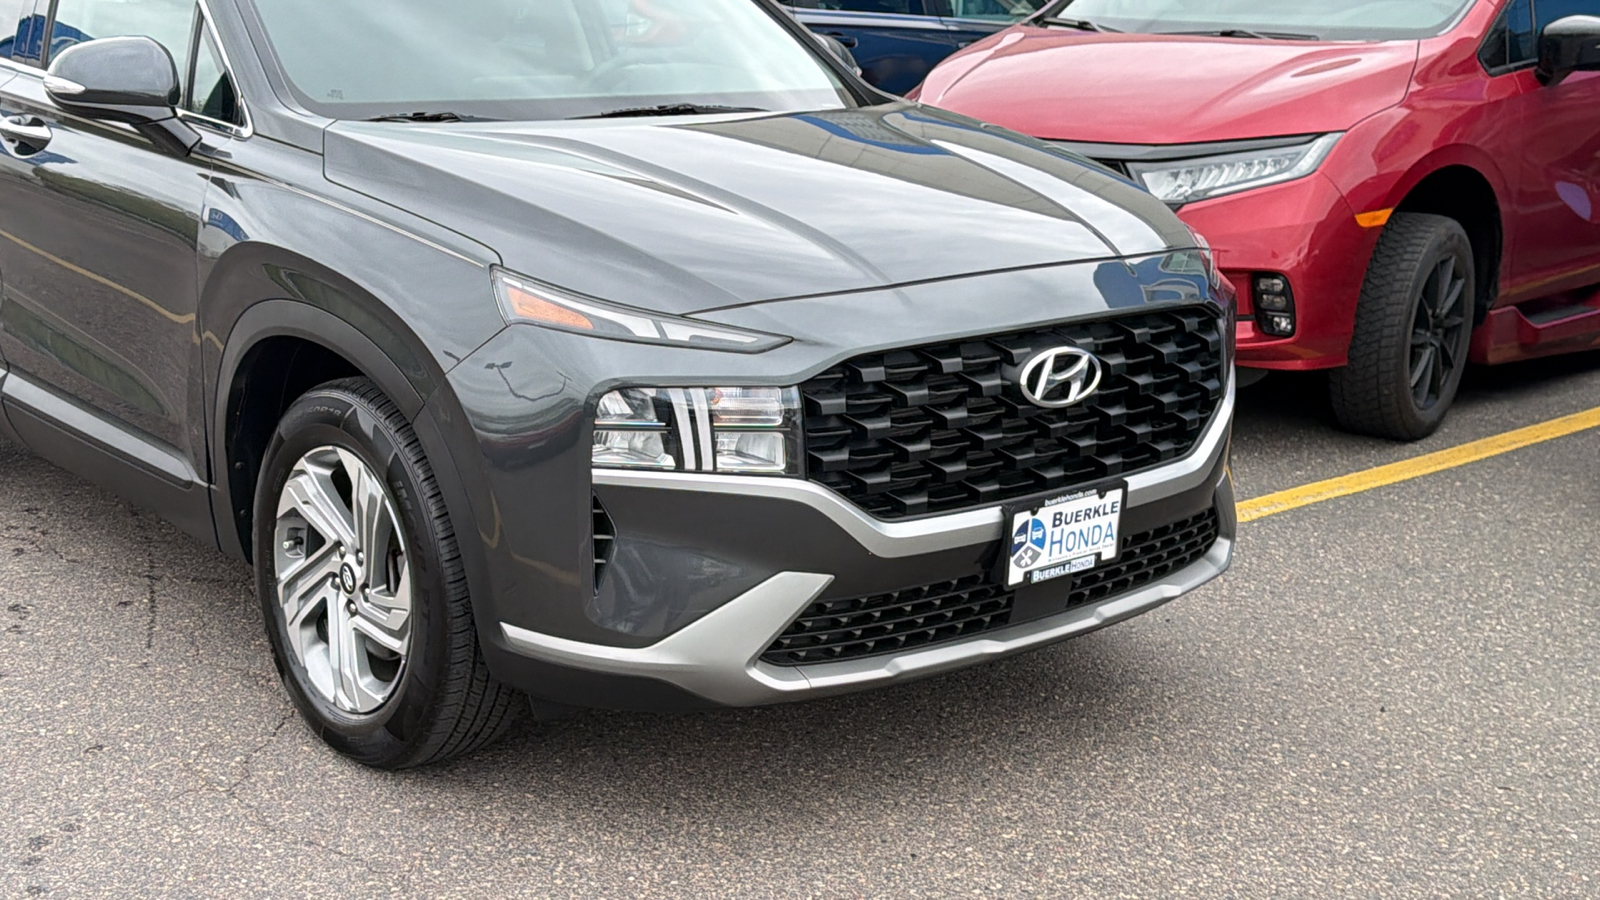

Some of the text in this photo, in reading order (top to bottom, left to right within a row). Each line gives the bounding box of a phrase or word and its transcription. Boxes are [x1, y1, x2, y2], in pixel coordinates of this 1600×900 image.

[1052, 501, 1119, 528] BUERKLE
[1049, 521, 1114, 557] HONDA
[1032, 559, 1093, 581] BUERKLE HONDA
